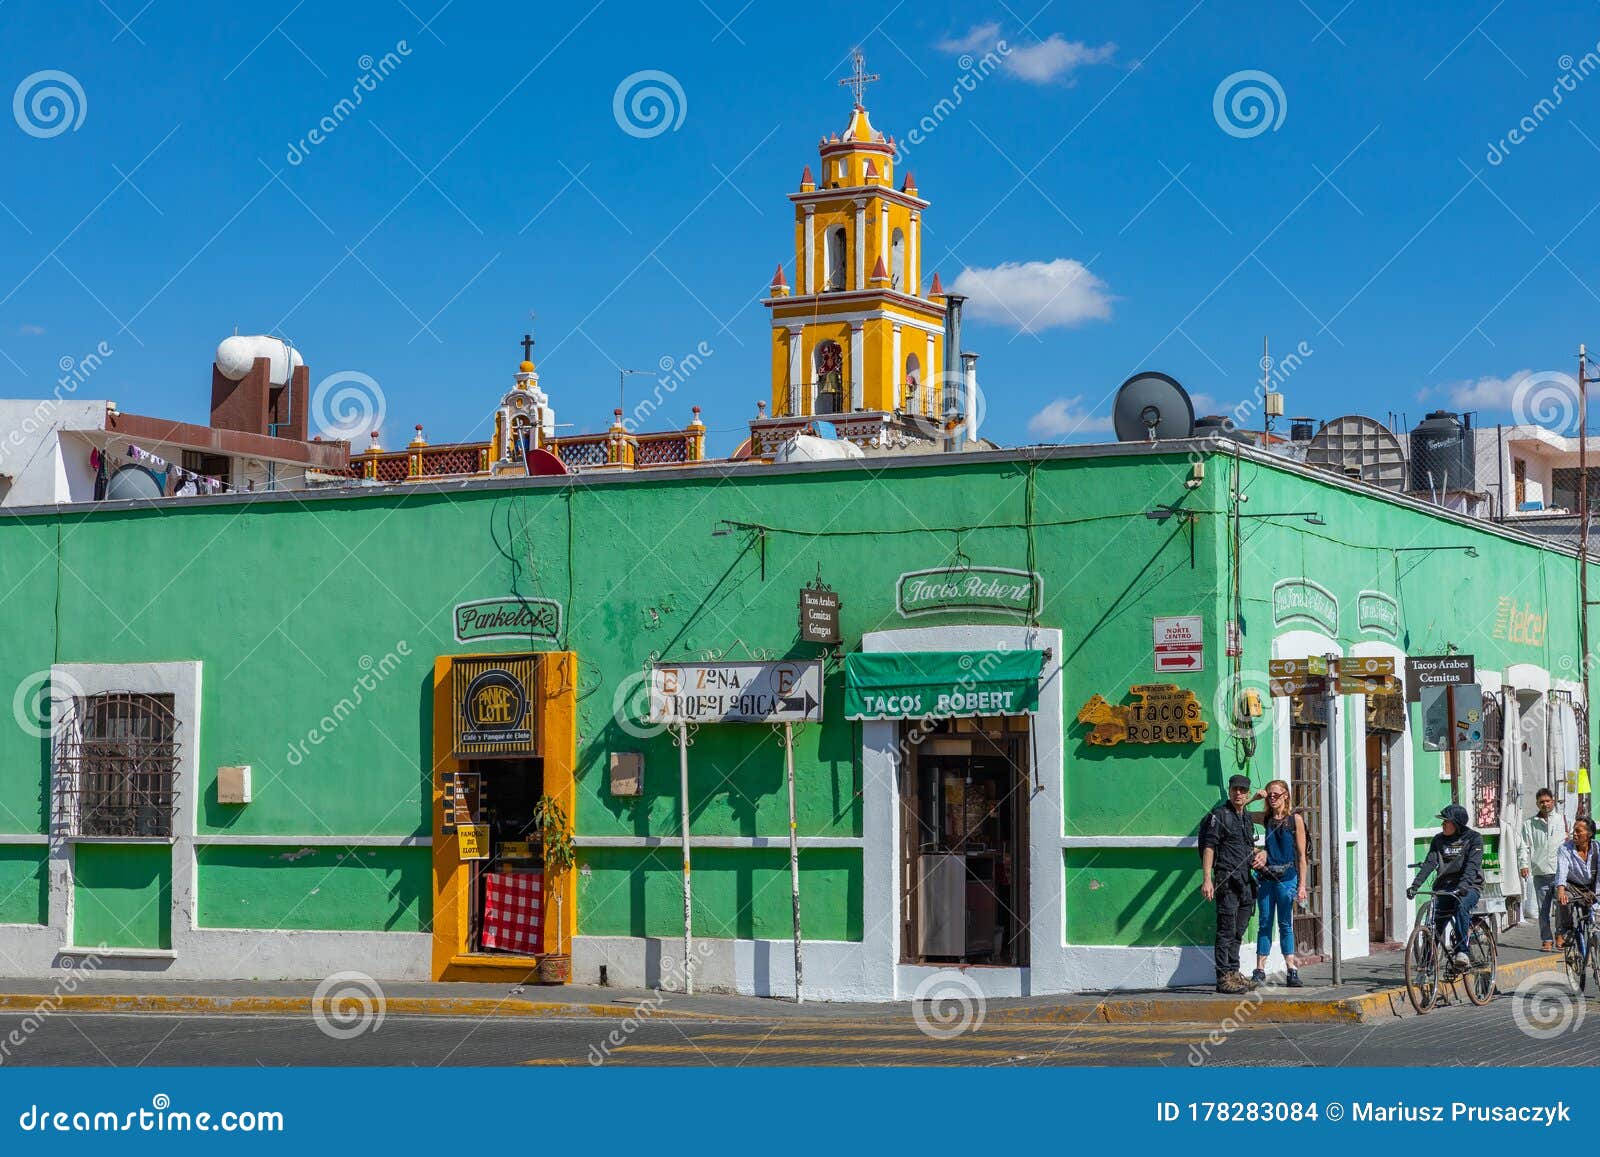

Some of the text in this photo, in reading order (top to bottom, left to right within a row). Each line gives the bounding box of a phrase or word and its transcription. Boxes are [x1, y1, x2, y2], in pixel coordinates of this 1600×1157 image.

[805, 594, 819, 605] Tacos
[809, 608, 831, 621] Cemitas
[1412, 660, 1469, 670] Tacos Arabes
[1419, 673, 1461, 683] Cemitas
[863, 690, 1014, 713] TACOS ROBERT
